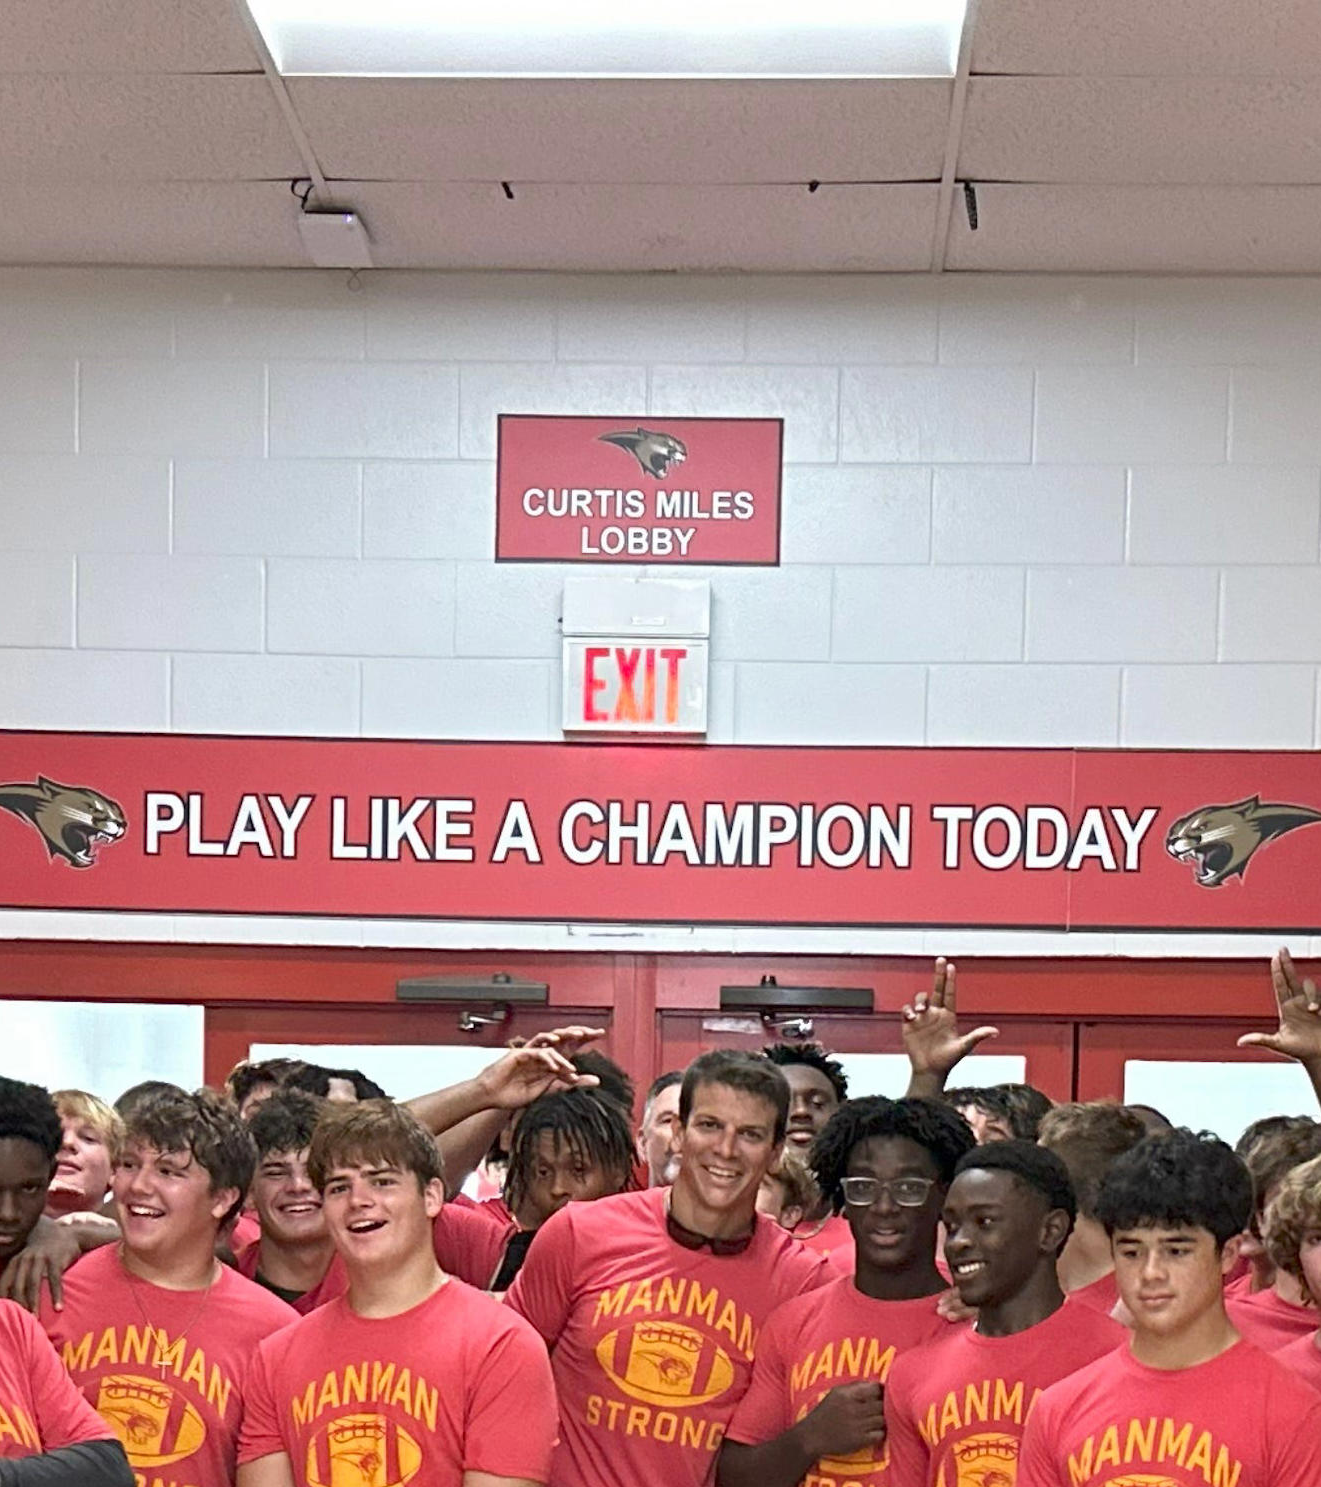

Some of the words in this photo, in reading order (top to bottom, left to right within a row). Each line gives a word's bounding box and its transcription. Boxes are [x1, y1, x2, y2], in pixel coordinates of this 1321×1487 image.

[522, 487, 645, 518] CURTIS
[655, 490, 755, 520] MILES
[580, 526, 696, 556] LOBBY
[582, 647, 688, 723] EXIT
[145, 792, 314, 858] PLAY
[331, 797, 474, 862] LIKE
[490, 800, 542, 864] A
[560, 800, 911, 868] CHAMPION
[932, 805, 1158, 871] TODAY
[591, 1276, 759, 1362] MANMAN
[62, 1324, 232, 1420] MANMAN
[291, 1360, 439, 1439] MANMAN
[790, 1336, 897, 1403] MANM
[586, 1395, 727, 1450] STRONG
[918, 1377, 1043, 1447] MANM
